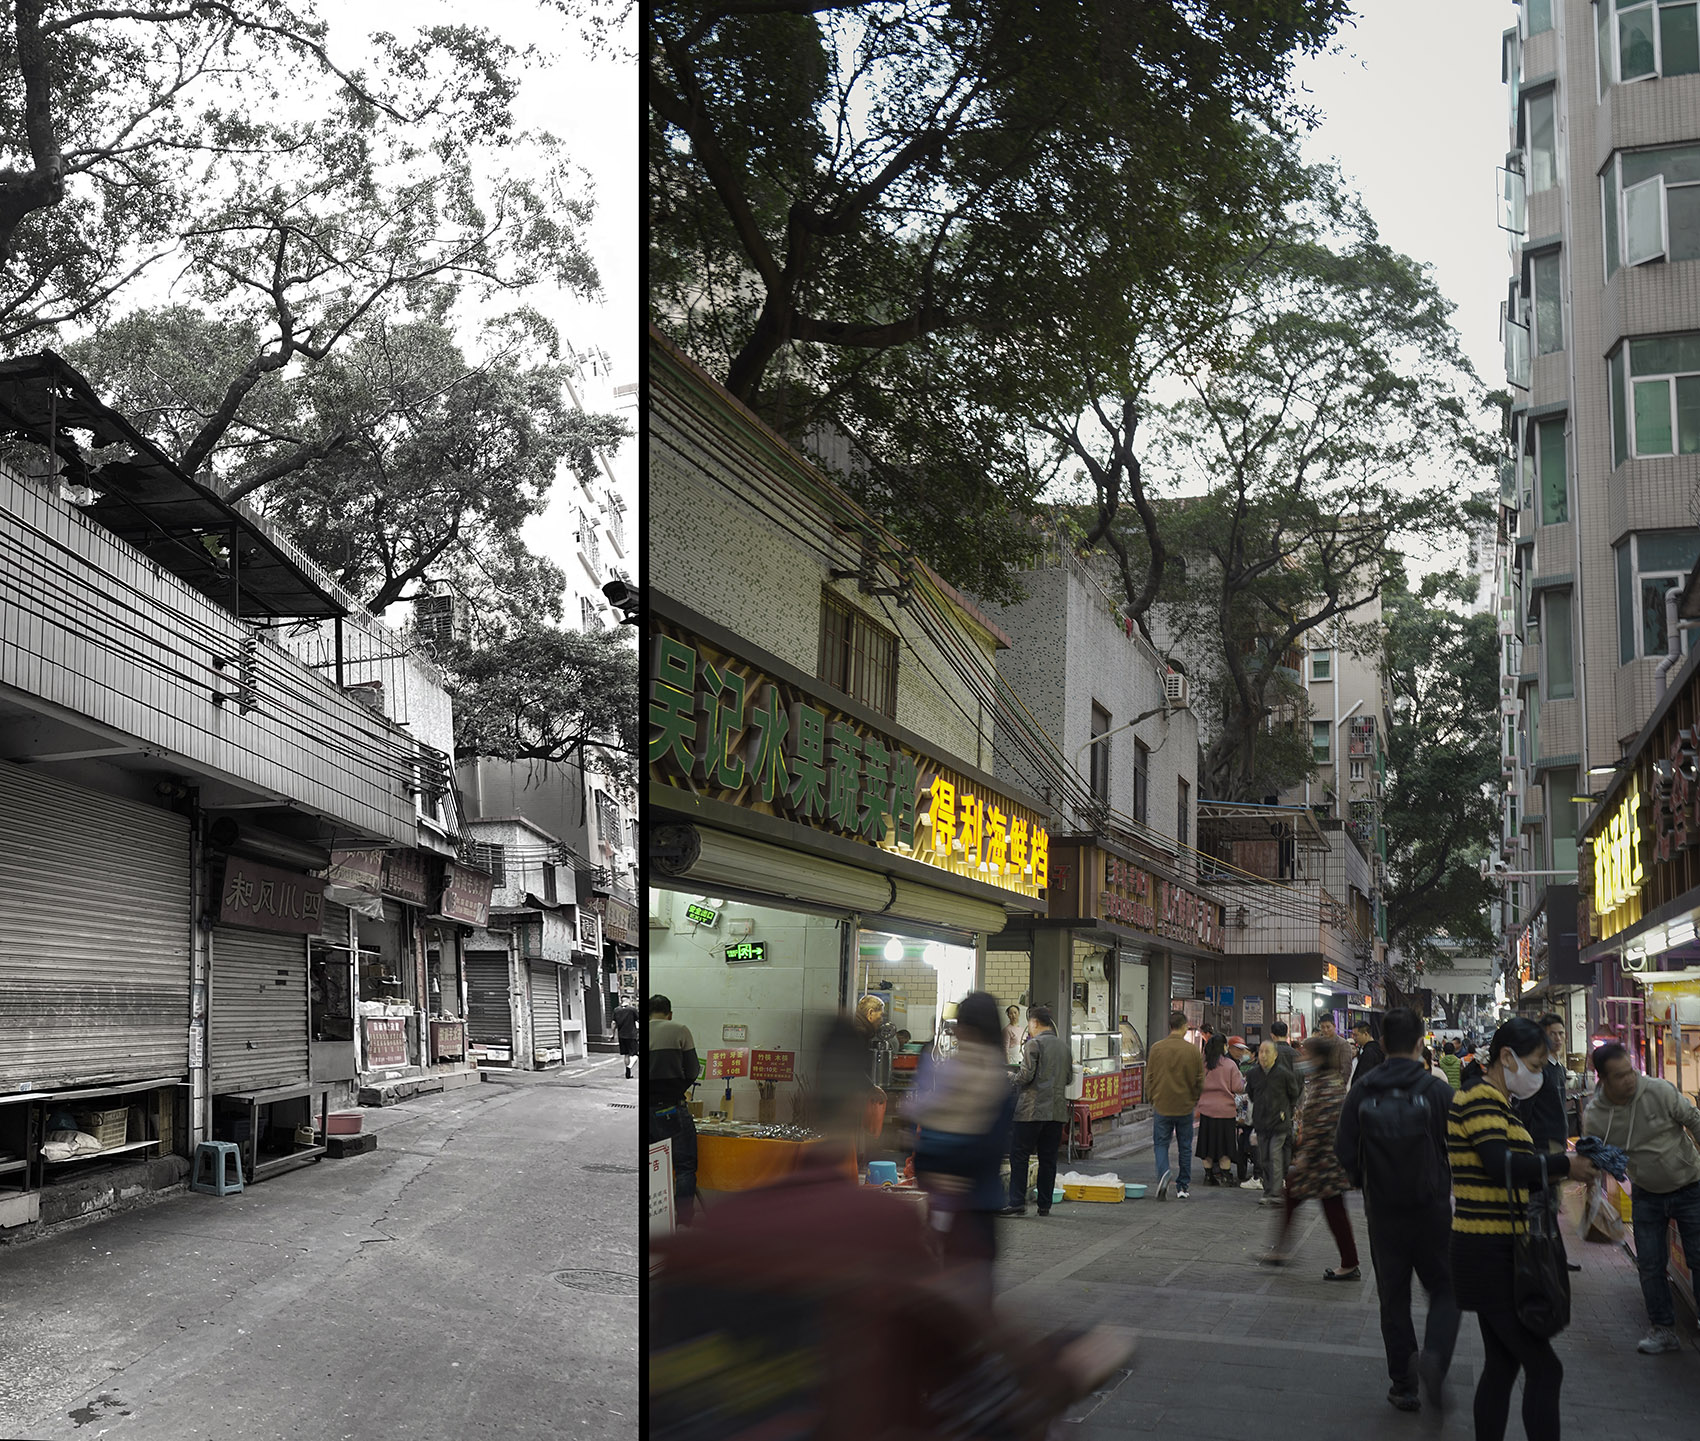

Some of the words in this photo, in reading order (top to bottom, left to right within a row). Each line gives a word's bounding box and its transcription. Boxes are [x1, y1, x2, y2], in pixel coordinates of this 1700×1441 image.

[648, 634, 917, 850] 吴记水果蔬菜档
[929, 774, 1048, 888] 得利海鲜档
[689, 905, 714, 920] 安全出口
[689, 913, 708, 923] EXIT
